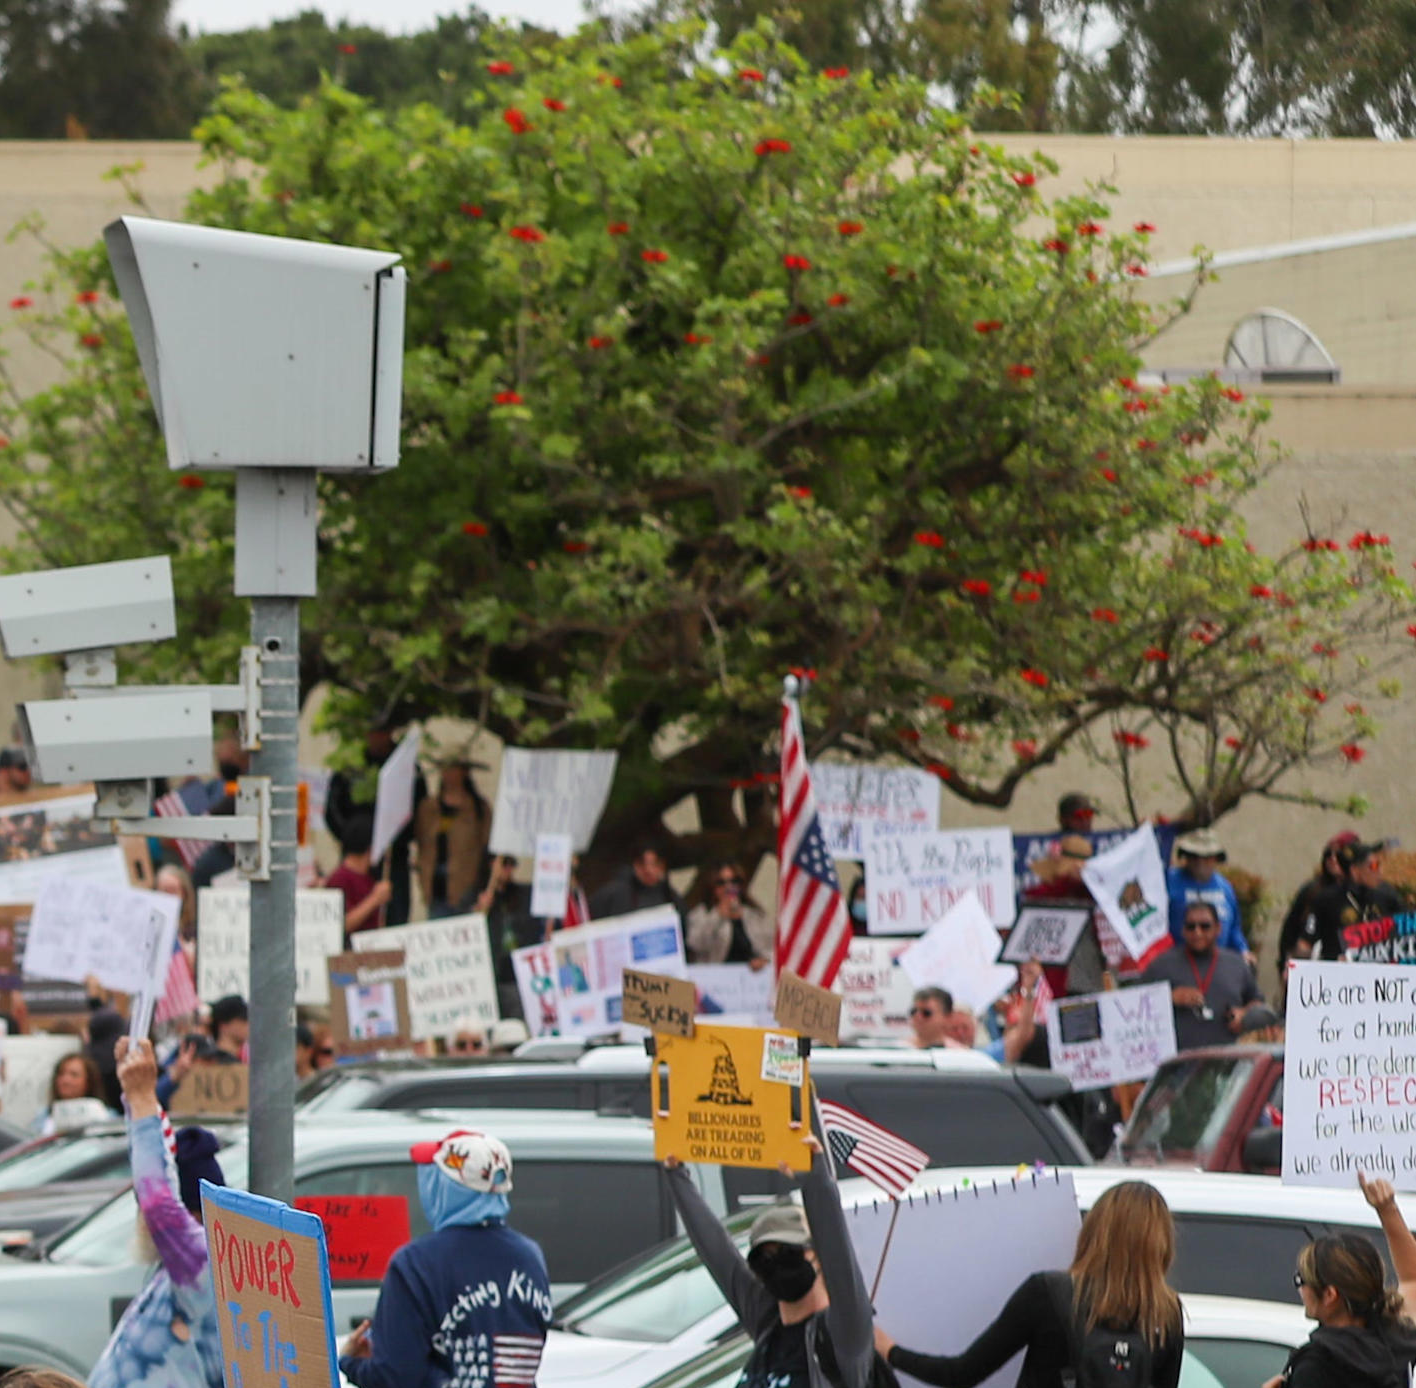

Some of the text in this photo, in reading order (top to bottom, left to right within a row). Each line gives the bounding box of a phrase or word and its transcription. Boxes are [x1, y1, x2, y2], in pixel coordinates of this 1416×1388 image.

[1342, 916, 1395, 949] STOP
[1299, 975, 1409, 1009] We are NOT
[1318, 1016, 1366, 1043] for a
[1298, 1056, 1329, 1081] we
[1336, 1053, 1379, 1078] are
[193, 1070, 242, 1100] NO
[687, 1111, 762, 1128] BILLIONAIRES
[1314, 1108, 1385, 1140] for the
[686, 1127, 766, 1145] ARE TREADING
[690, 1144, 762, 1162] ON ALL OF US
[1294, 1145, 1396, 1181] we already
[212, 1219, 301, 1308] POWER
[226, 1300, 299, 1374] To The
